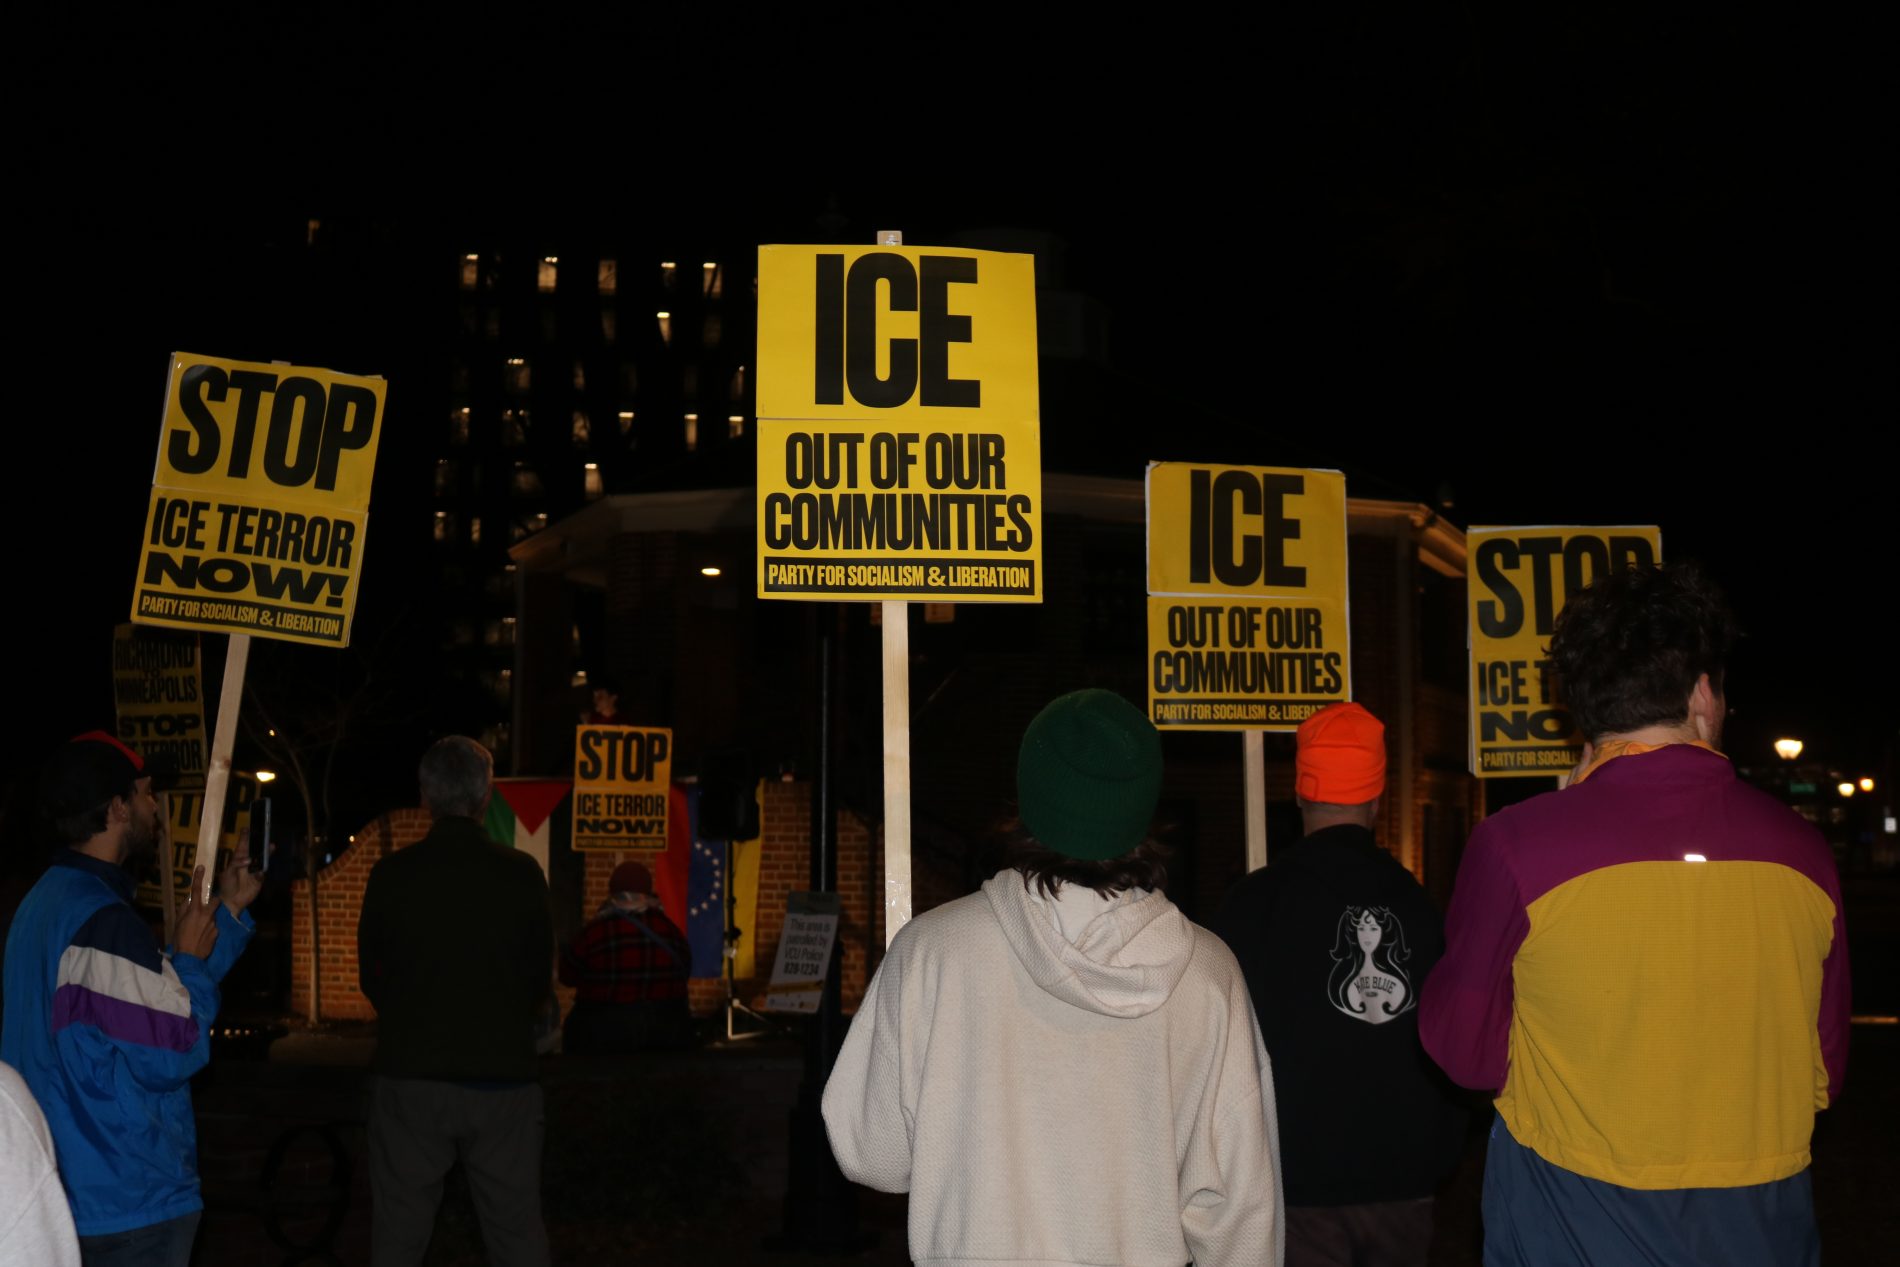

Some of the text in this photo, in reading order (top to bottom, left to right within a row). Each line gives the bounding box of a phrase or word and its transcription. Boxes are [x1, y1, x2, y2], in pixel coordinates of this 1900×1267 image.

[815, 252, 980, 408] ICE
[168, 364, 377, 491] STOP
[785, 432, 1006, 490] OUT OF OUR
[150, 497, 355, 569] ICE TERROR
[764, 492, 1033, 552] COMMUNITIES
[1190, 469, 1307, 588] ICE
[144, 551, 350, 608] NOW!
[768, 564, 1030, 588] PARTY FOR SOCIALISM & LIBERATION
[1476, 535, 1656, 638] STO
[141, 595, 340, 636] PARTY FOR SOCIALISM & LIBERATION
[1168, 606, 1323, 649] OUT OF OUR
[1154, 651, 1342, 694] COMMUNITIES
[1478, 660, 1529, 707] ICE
[119, 713, 200, 738] STOP
[1156, 703, 1324, 721] PARTY FOR SOCIALISM & LIBERA
[1480, 710, 1575, 742] NO
[579, 730, 668, 782] STOP
[1484, 752, 1518, 767] PARTY
[1516, 752, 1537, 766] FOR
[576, 818, 665, 834] NOW!
[577, 794, 665, 816] ICE TERROR
[1372, 976, 1396, 994] BLUE
